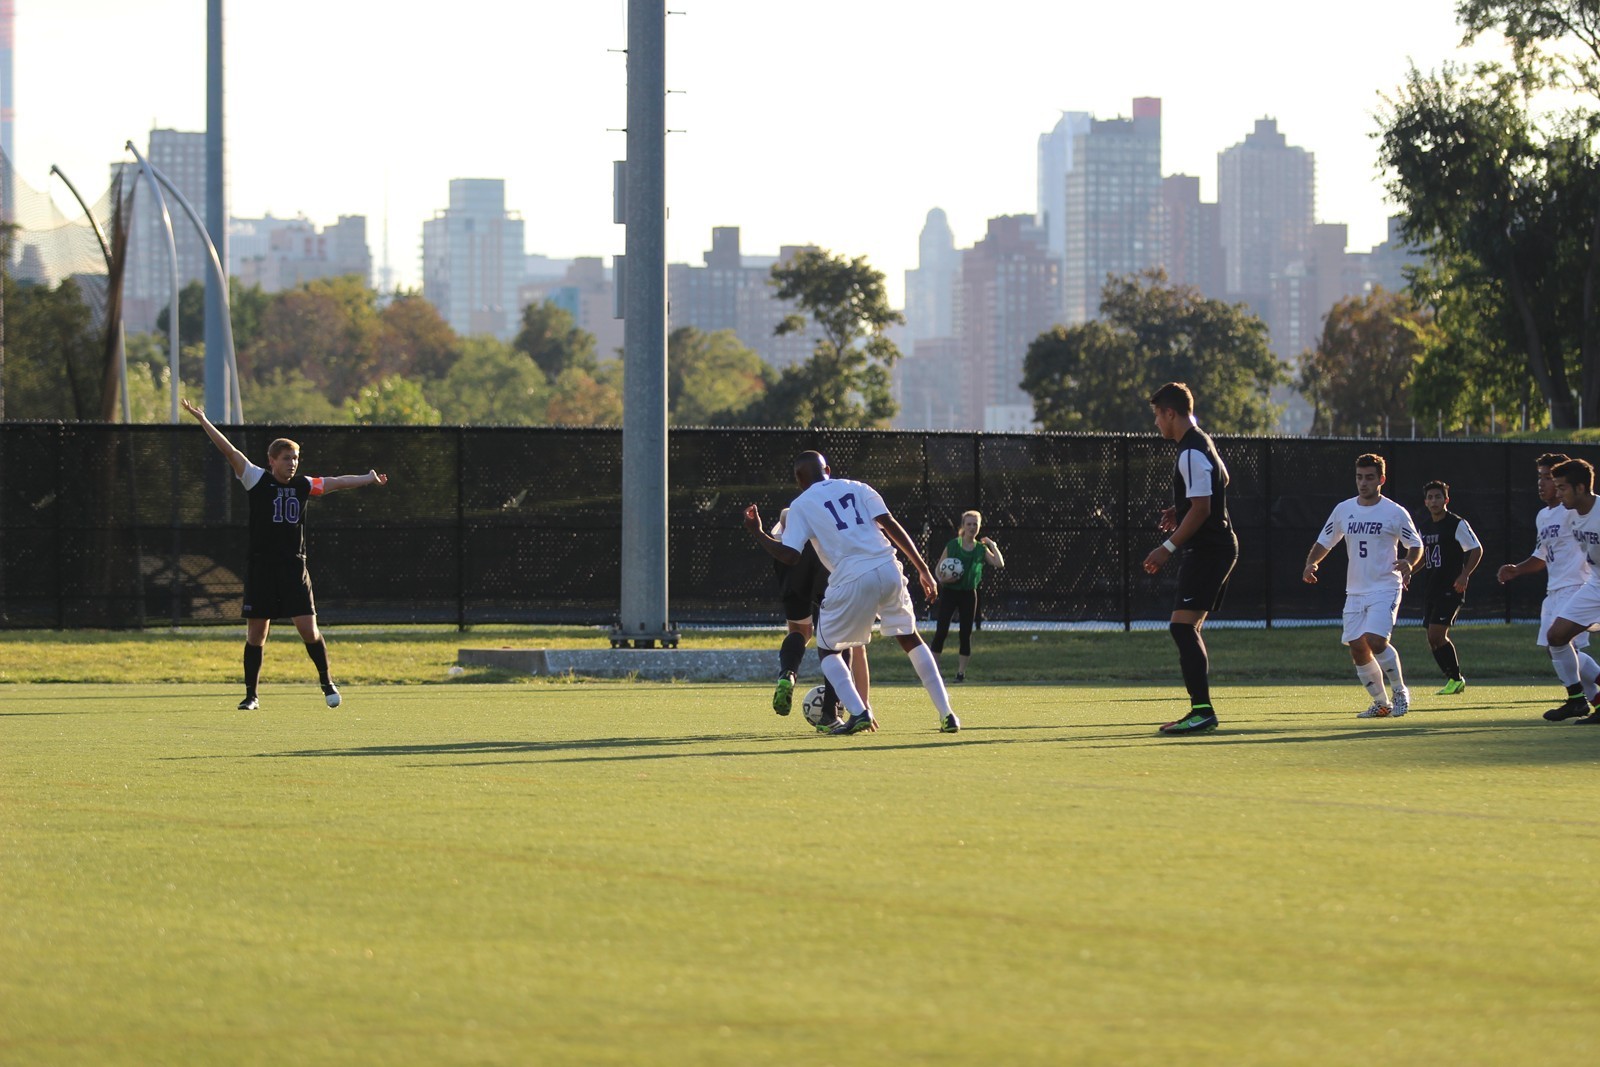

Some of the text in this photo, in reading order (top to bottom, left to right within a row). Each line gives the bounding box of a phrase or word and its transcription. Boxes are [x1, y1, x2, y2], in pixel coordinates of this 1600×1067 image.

[272, 496, 300, 524] 10
[823, 492, 865, 531] 17
[1347, 521, 1383, 535] HUNTER
[1359, 540, 1368, 559] 5
[1424, 544, 1442, 569] 14
